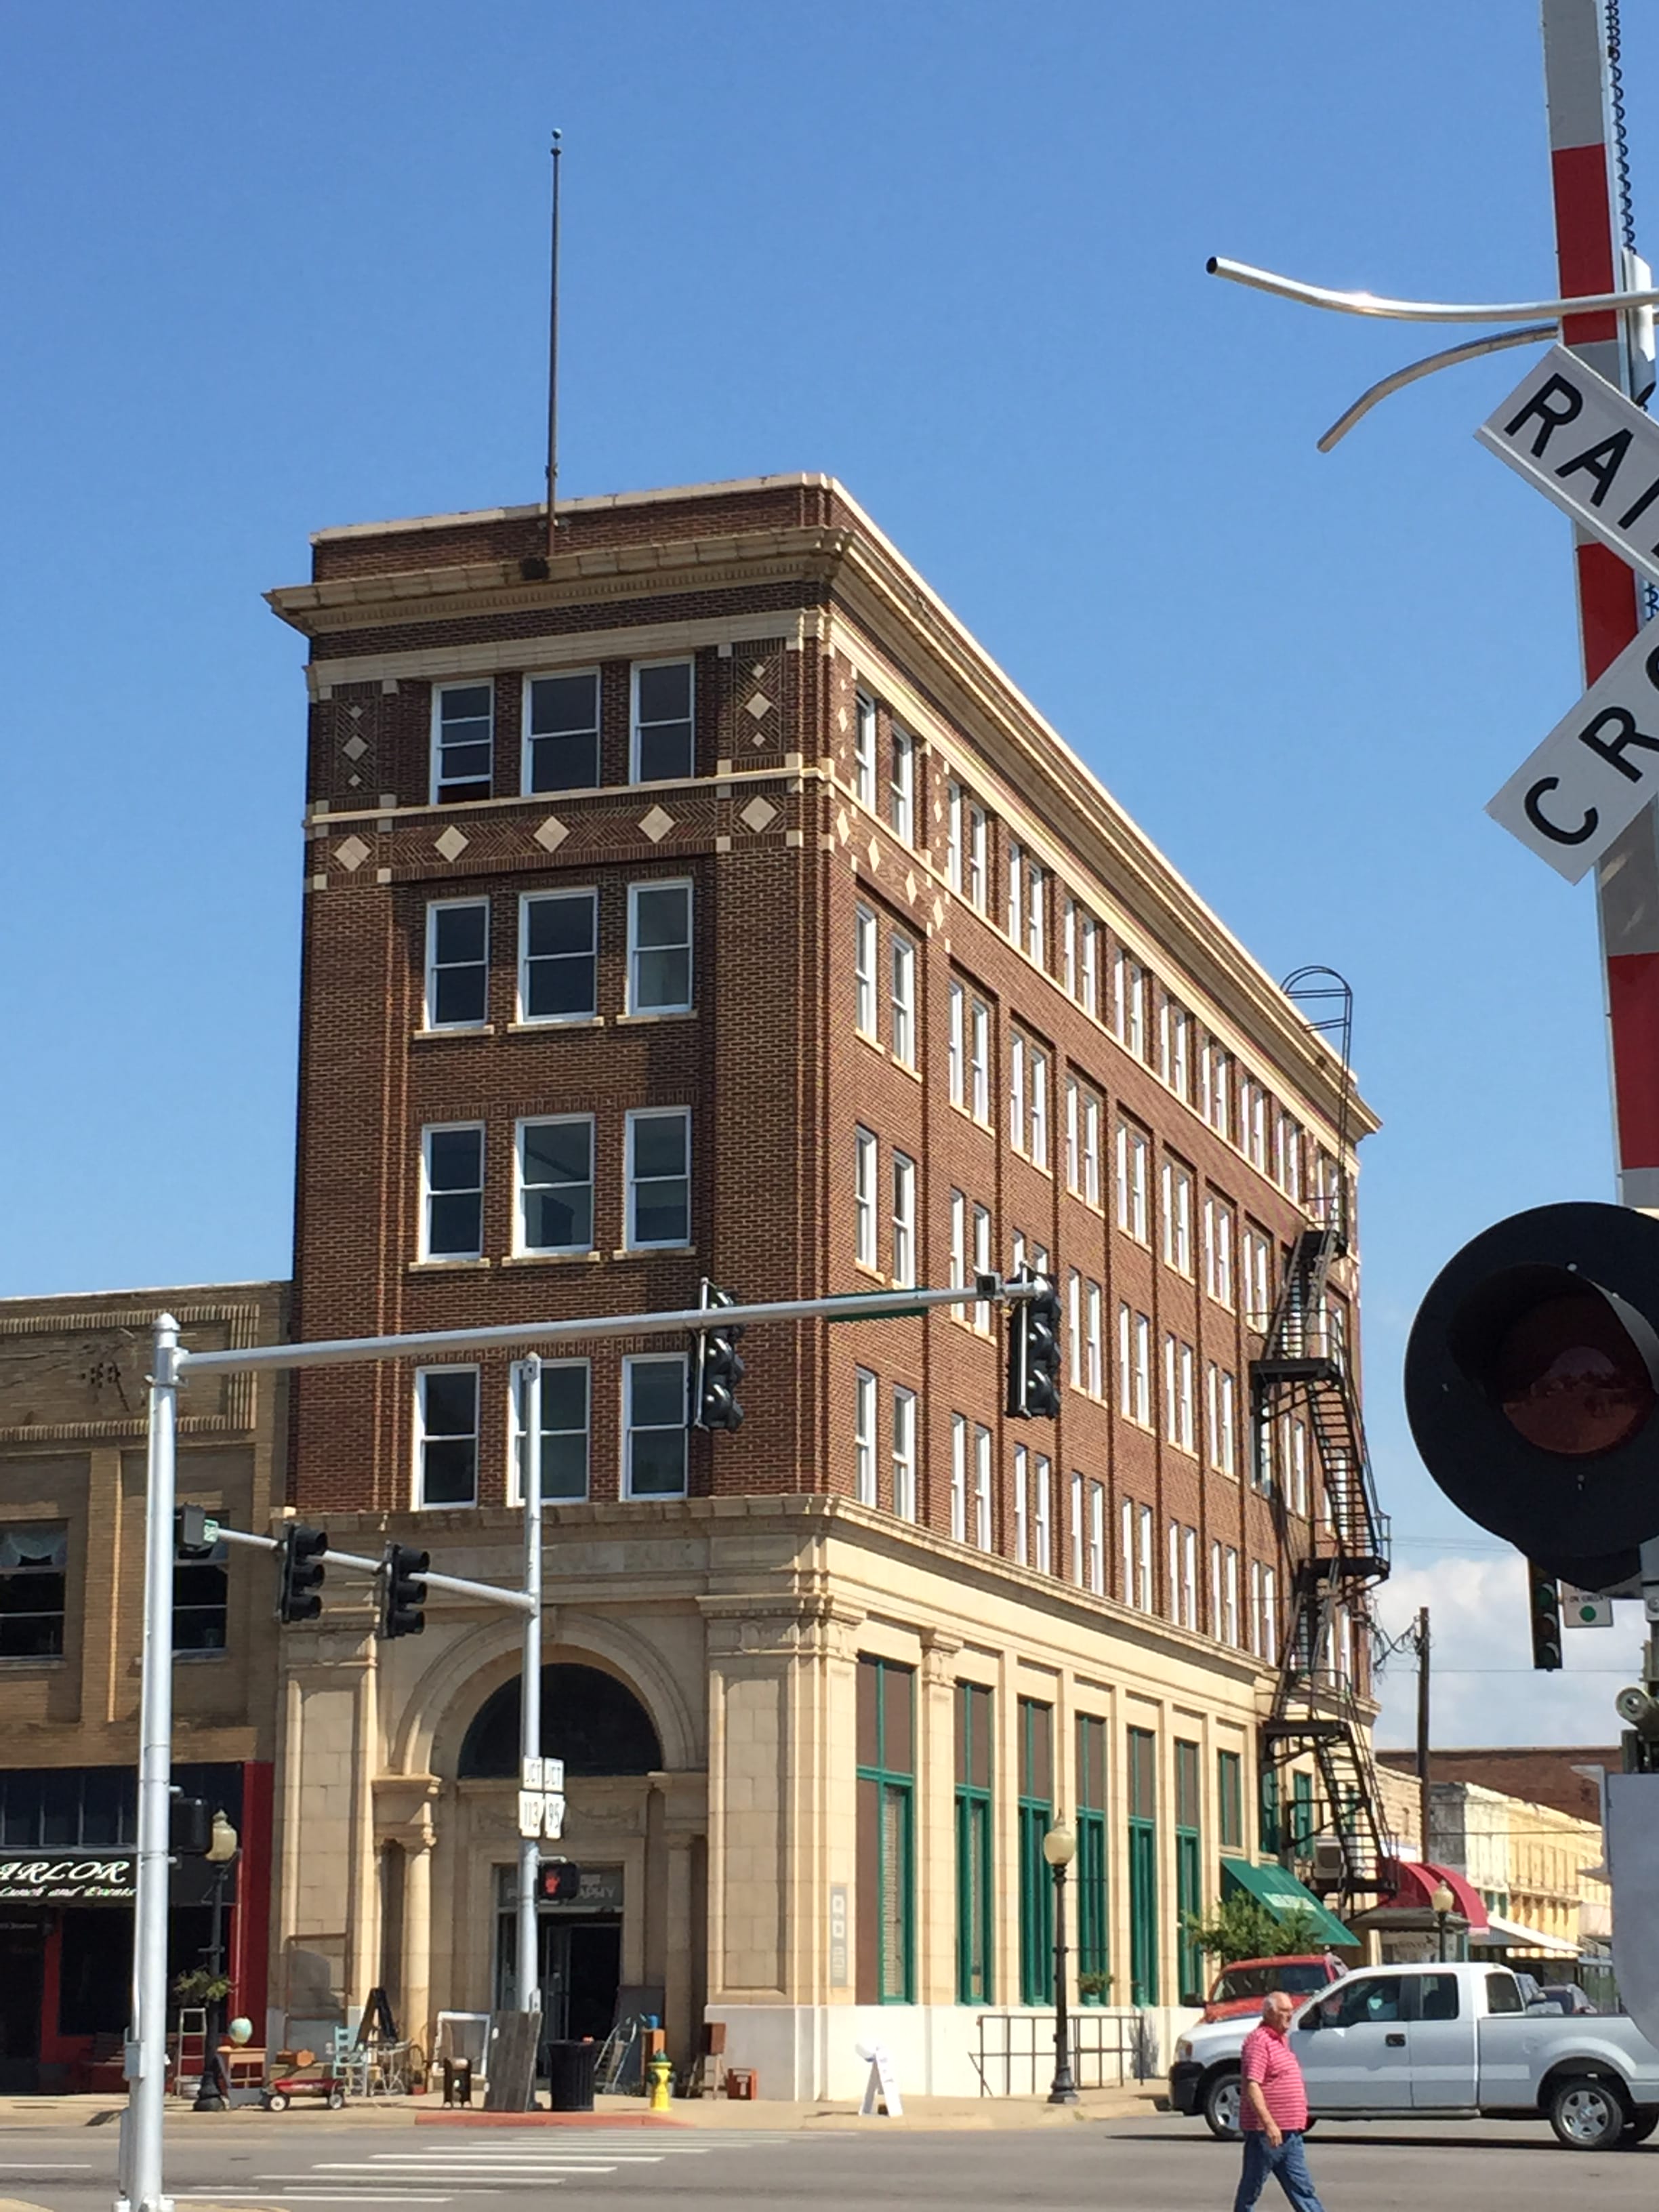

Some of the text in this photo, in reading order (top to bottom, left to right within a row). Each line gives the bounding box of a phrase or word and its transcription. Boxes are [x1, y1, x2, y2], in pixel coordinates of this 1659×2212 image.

[1503, 373, 1659, 558] RAI
[1525, 646, 1659, 845] CR
[526, 1763, 541, 1783] JCT
[545, 1766, 561, 1786] JCT
[524, 1801, 539, 1828] 113
[548, 1802, 560, 1828] 95
[48, 1885, 85, 1896] and
